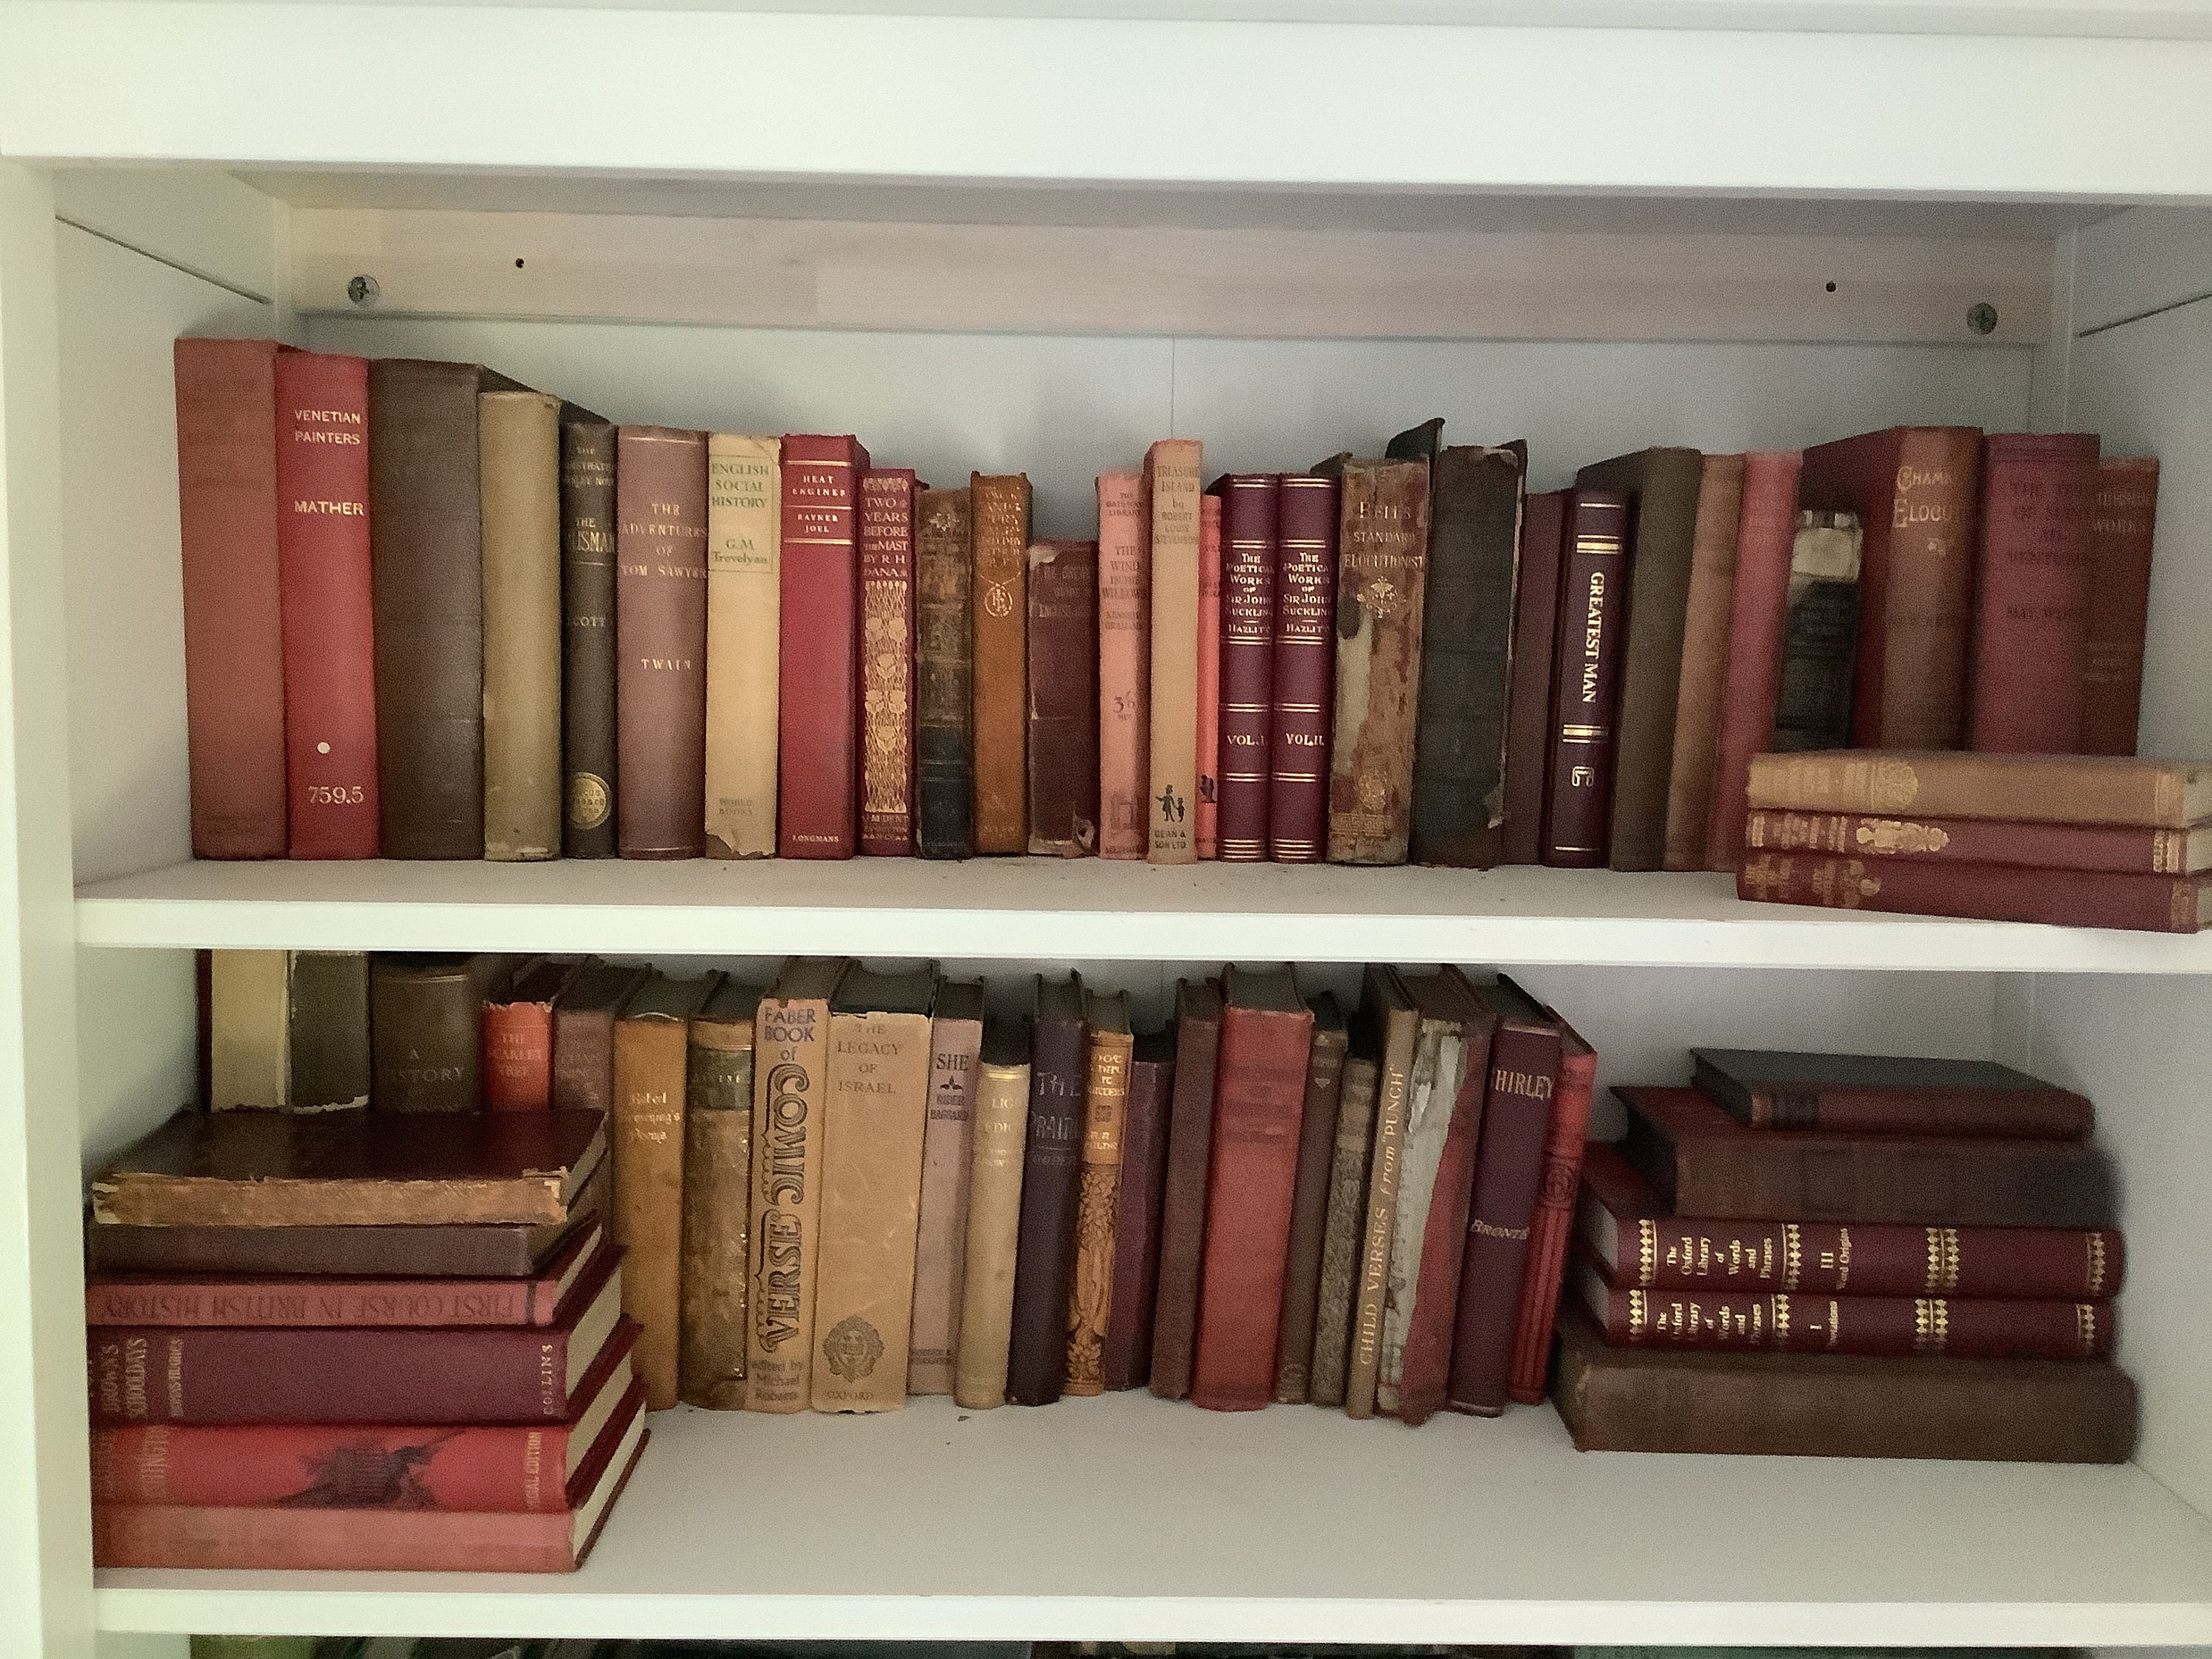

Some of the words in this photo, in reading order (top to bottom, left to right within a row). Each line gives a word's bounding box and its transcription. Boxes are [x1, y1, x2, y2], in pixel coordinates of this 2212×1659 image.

[295, 409, 361, 425] VENETIAN
[295, 430, 361, 446] PAINTERS
[712, 462, 770, 477] ENGLISH
[1157, 465, 1200, 477] TREASURE
[803, 475, 835, 484] HEAT
[714, 479, 764, 493] SOCIAL
[792, 487, 846, 497] ENGINES
[1161, 481, 1195, 493] ISLAND
[295, 500, 364, 516] MATHER
[712, 496, 768, 509] HISTORY
[864, 498, 897, 508] TWO
[652, 503, 680, 516] THE
[1108, 509, 1141, 517] LIBRARY
[798, 514, 838, 523] RAYNER
[864, 512, 908, 523] YEARS
[1161, 512, 1193, 521] ROBERT
[576, 518, 597, 528] THE
[804, 524, 830, 533] JOEL
[622, 523, 708, 538] ADVENTURES
[863, 526, 908, 537] BEFORE
[1155, 535, 1199, 545] STEVENSON
[1353, 531, 1416, 543] STANDARD
[656, 545, 674, 557] OF
[878, 540, 908, 551] MAST
[1115, 546, 1135, 556] THE
[712, 550, 768, 565] Trevelyan
[863, 555, 876, 563] BY
[882, 555, 891, 563] R
[895, 555, 905, 563] H
[1242, 552, 1261, 563] THE
[1300, 552, 1319, 563] THE
[1110, 560, 1140, 571] WIND
[622, 565, 648, 577] TOM
[658, 565, 708, 579] SAWYER
[863, 568, 898, 577] DANA
[1230, 574, 1270, 585] WORKS
[1288, 573, 1330, 584] WORKS
[1283, 594, 1300, 604] SIR
[1583, 571, 1605, 658] GREATEST
[641, 658, 692, 670] TWAIN
[1582, 659, 1599, 703] MAN
[308, 785, 364, 804] 759.5
[1154, 830, 1178, 838] DEAN
[1154, 841, 1169, 849] SON
[1171, 841, 1186, 849] LTD
[764, 1007, 816, 1024] FABER
[764, 1026, 815, 1043] BOOK
[855, 1023, 885, 1034] THE
[779, 1046, 799, 1062] of
[838, 1040, 902, 1056] LEGACY
[936, 1053, 970, 1071] SHE
[858, 1063, 879, 1074] OF
[838, 1081, 897, 1094] ISRAEL
[936, 1095, 964, 1106] RIDER
[765, 1063, 810, 1206] COMIC
[1367, 1208, 1388, 1292] VERSES
[1667, 1246, 1677, 1266] The
[1680, 1237, 1693, 1276] Oxford
[1696, 1237, 1711, 1276] Library
[1714, 1253, 1725, 1264] of
[1729, 1239, 1741, 1275] Words
[1745, 1248, 1756, 1269] and
[1760, 1237, 1773, 1279] Phrases
[1820, 1252, 1834, 1269] III
[758, 1209, 802, 1353] VERSE
[1657, 1312, 1667, 1330] The
[1735, 1314, 1745, 1335] and
[1360, 1303, 1378, 1365] CHILD
[541, 1343, 554, 1416] COLLINS
[827, 1391, 874, 1400] OXFORD
